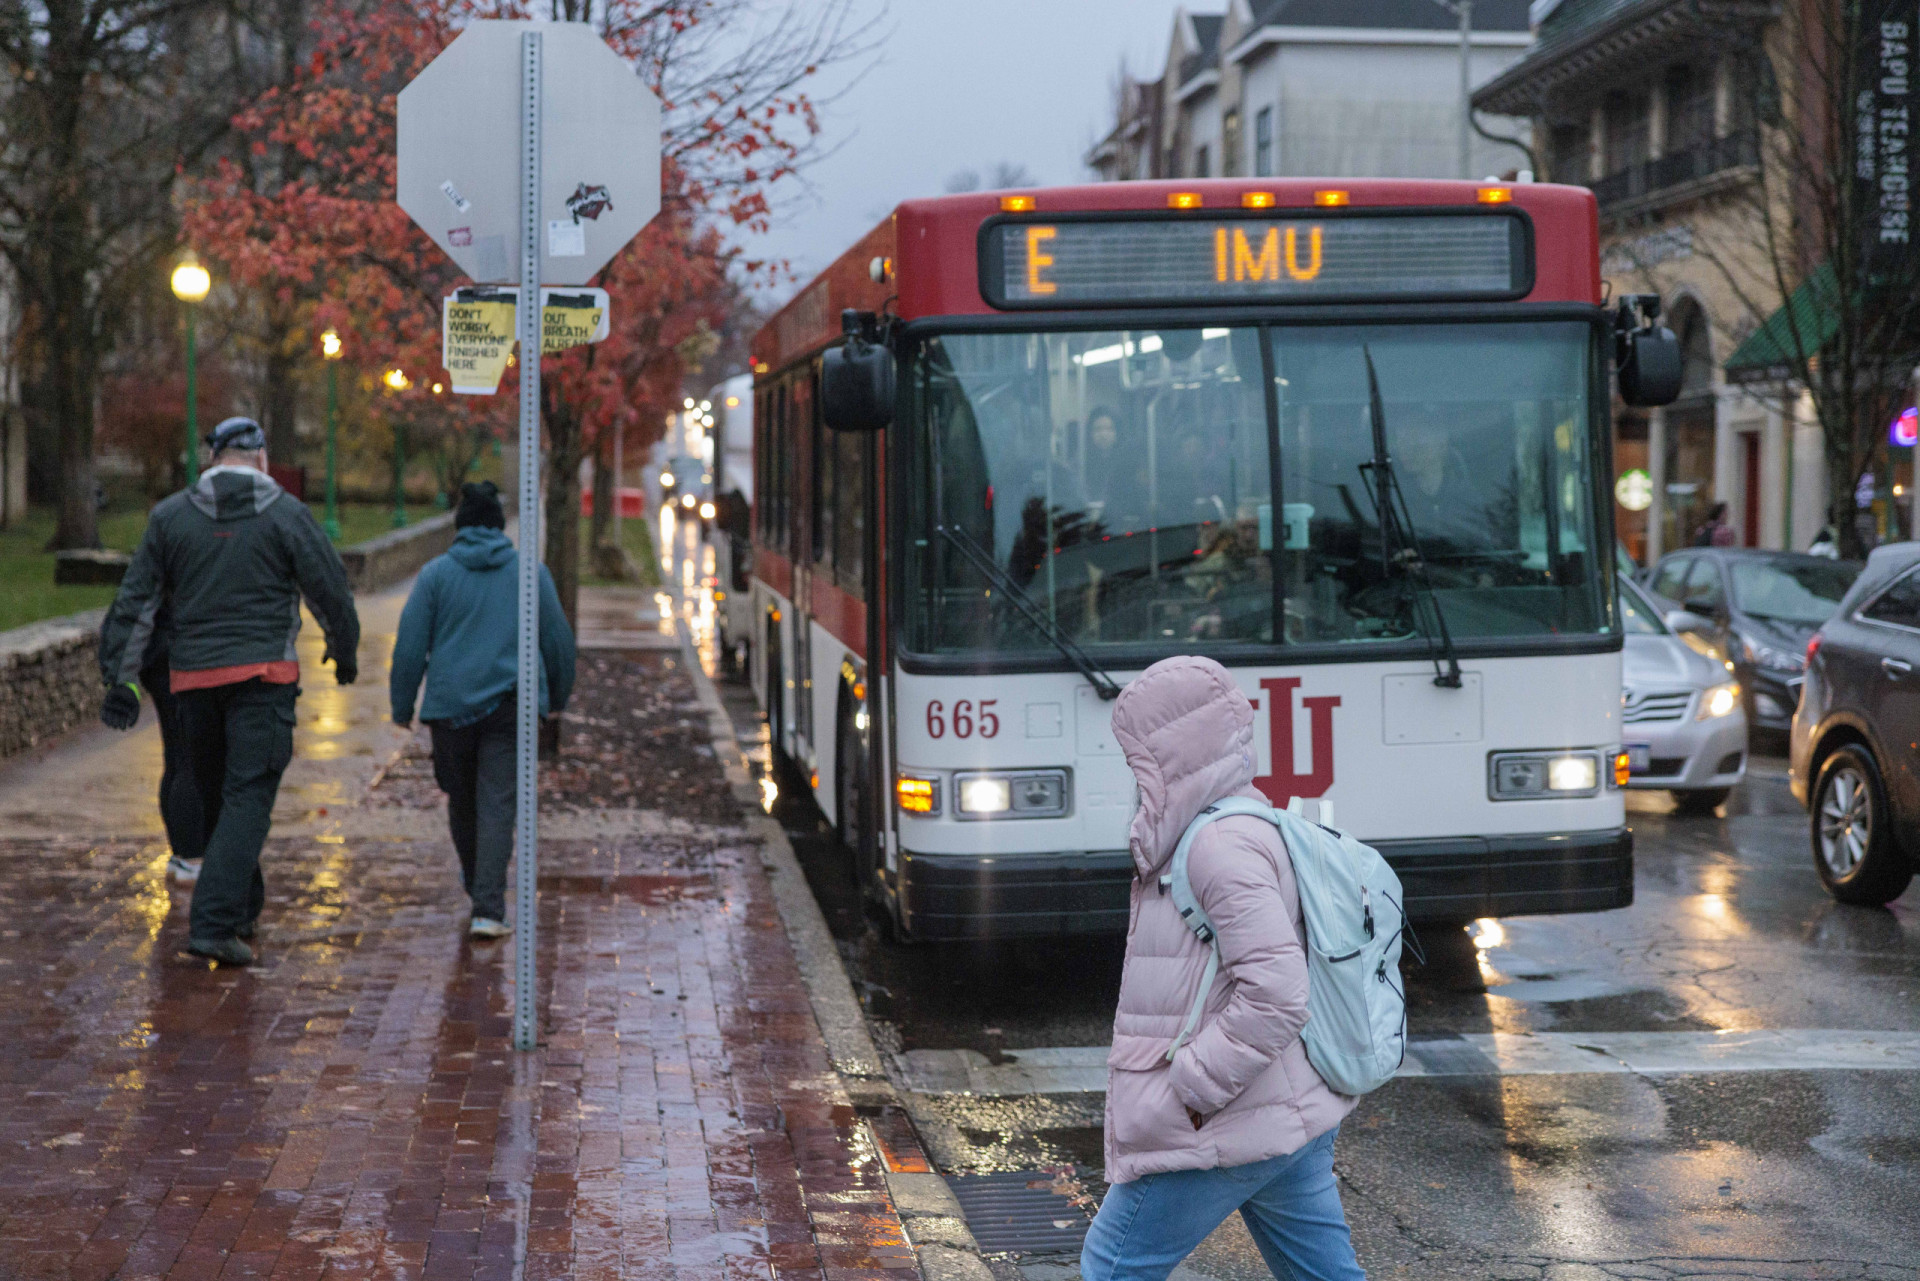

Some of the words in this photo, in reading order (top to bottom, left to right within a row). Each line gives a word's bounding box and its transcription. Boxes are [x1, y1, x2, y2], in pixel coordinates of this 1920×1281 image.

[1880, 21, 1909, 95] BAPU
[1880, 105, 1910, 244] TEAHOUSE
[1026, 226, 1057, 295] E
[1214, 225, 1323, 282] IMU
[448, 309, 482, 320] DON'T
[544, 313, 566, 325] OUT
[544, 325, 589, 338] BREATH
[448, 334, 507, 346] EVERYONE
[448, 346, 499, 358] FINISHES
[448, 359, 476, 371] HERE
[926, 700, 1000, 740] 665
